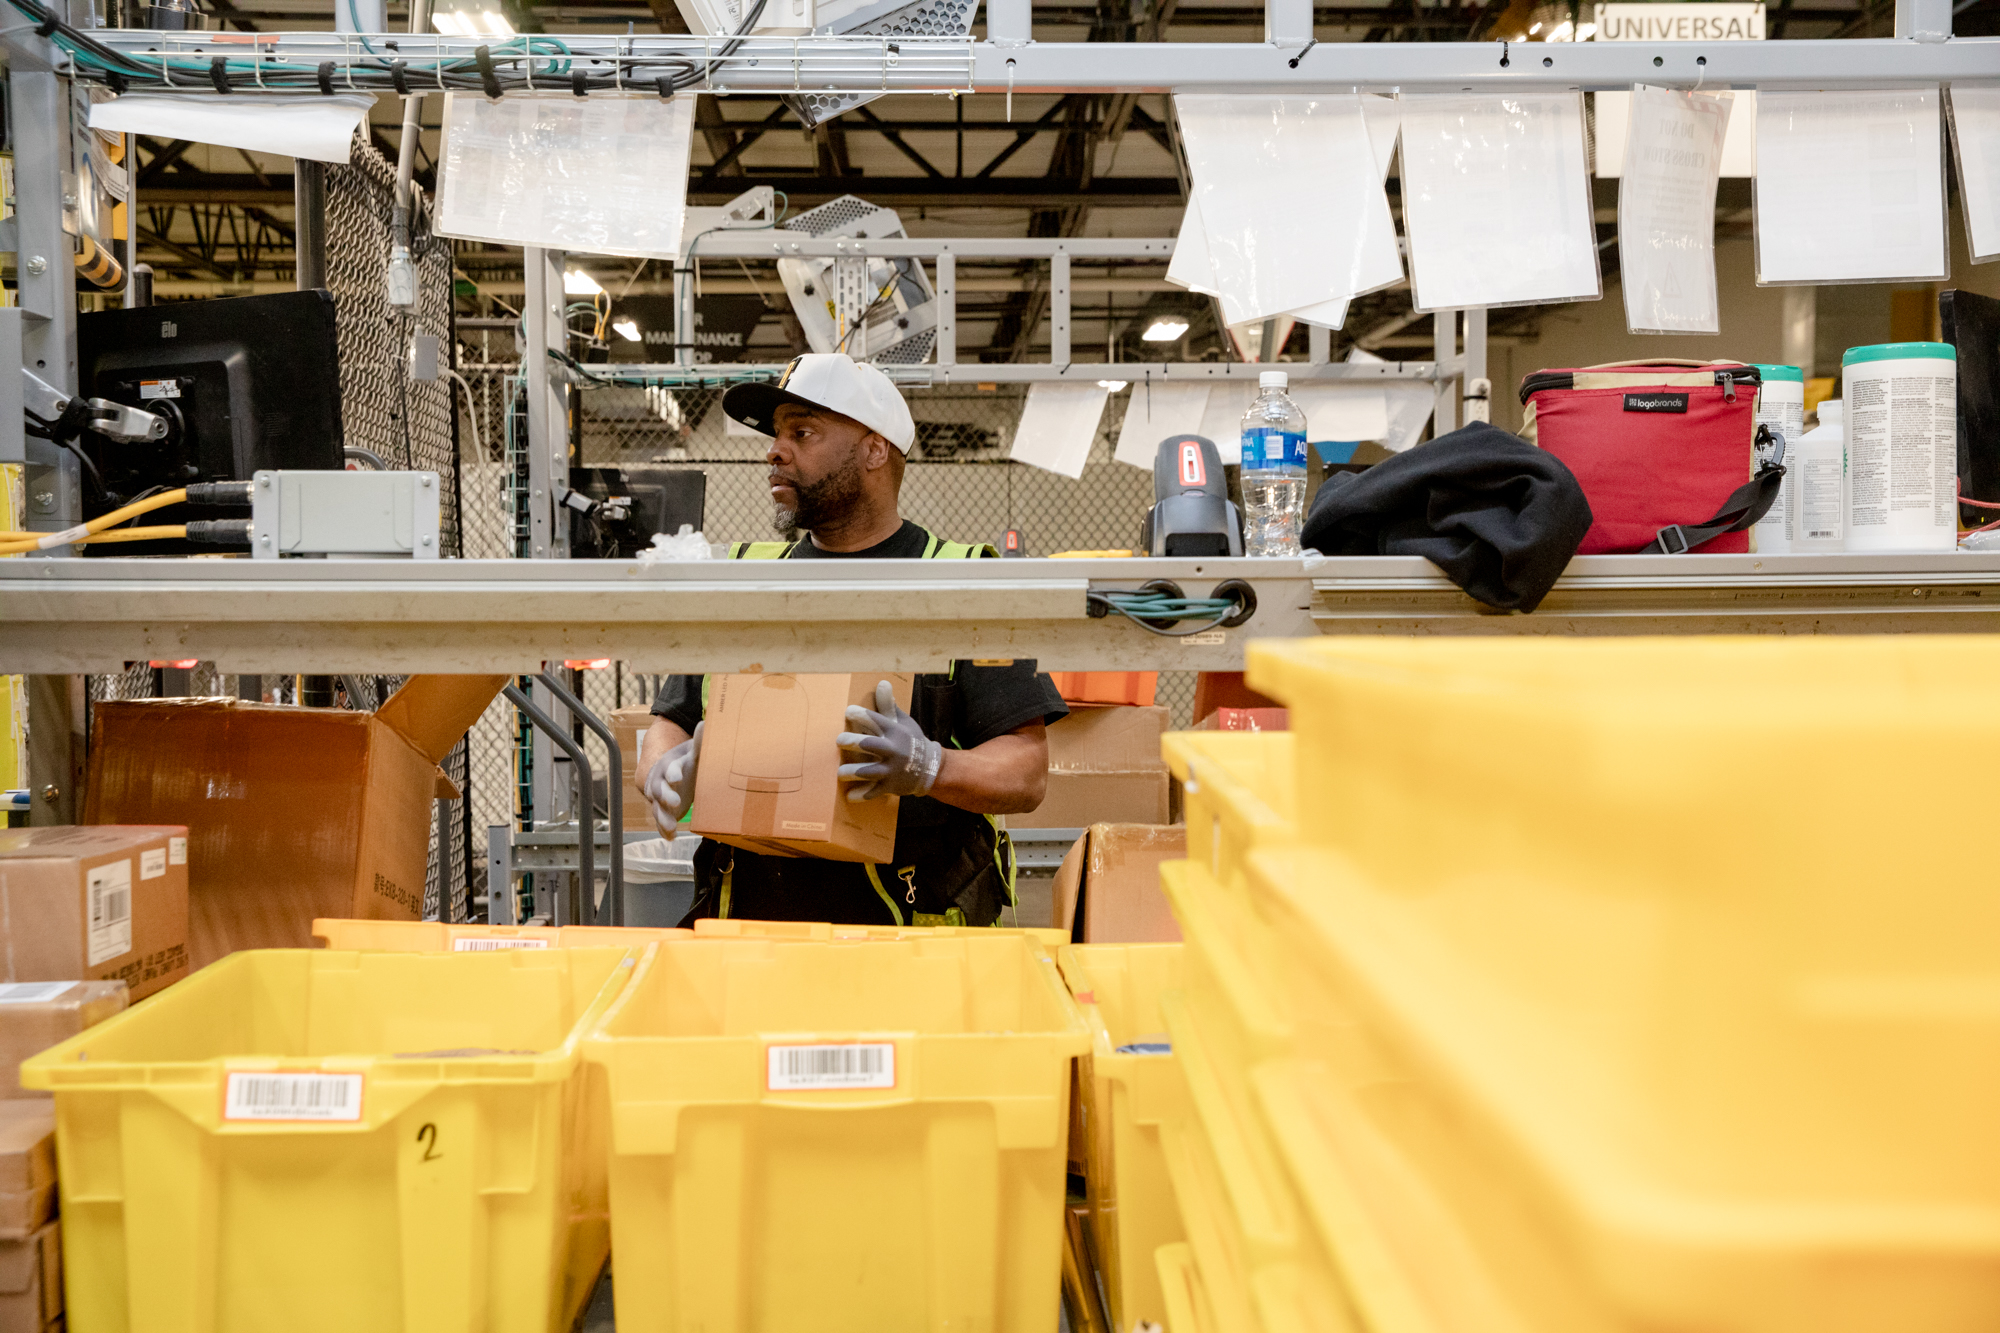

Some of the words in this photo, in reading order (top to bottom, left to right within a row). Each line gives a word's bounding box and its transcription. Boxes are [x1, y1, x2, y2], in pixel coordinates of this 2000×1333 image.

[1603, 17, 1758, 39] UNIVERSAL
[1637, 398, 1682, 410] logobrands
[416, 1123, 442, 1163] 2
